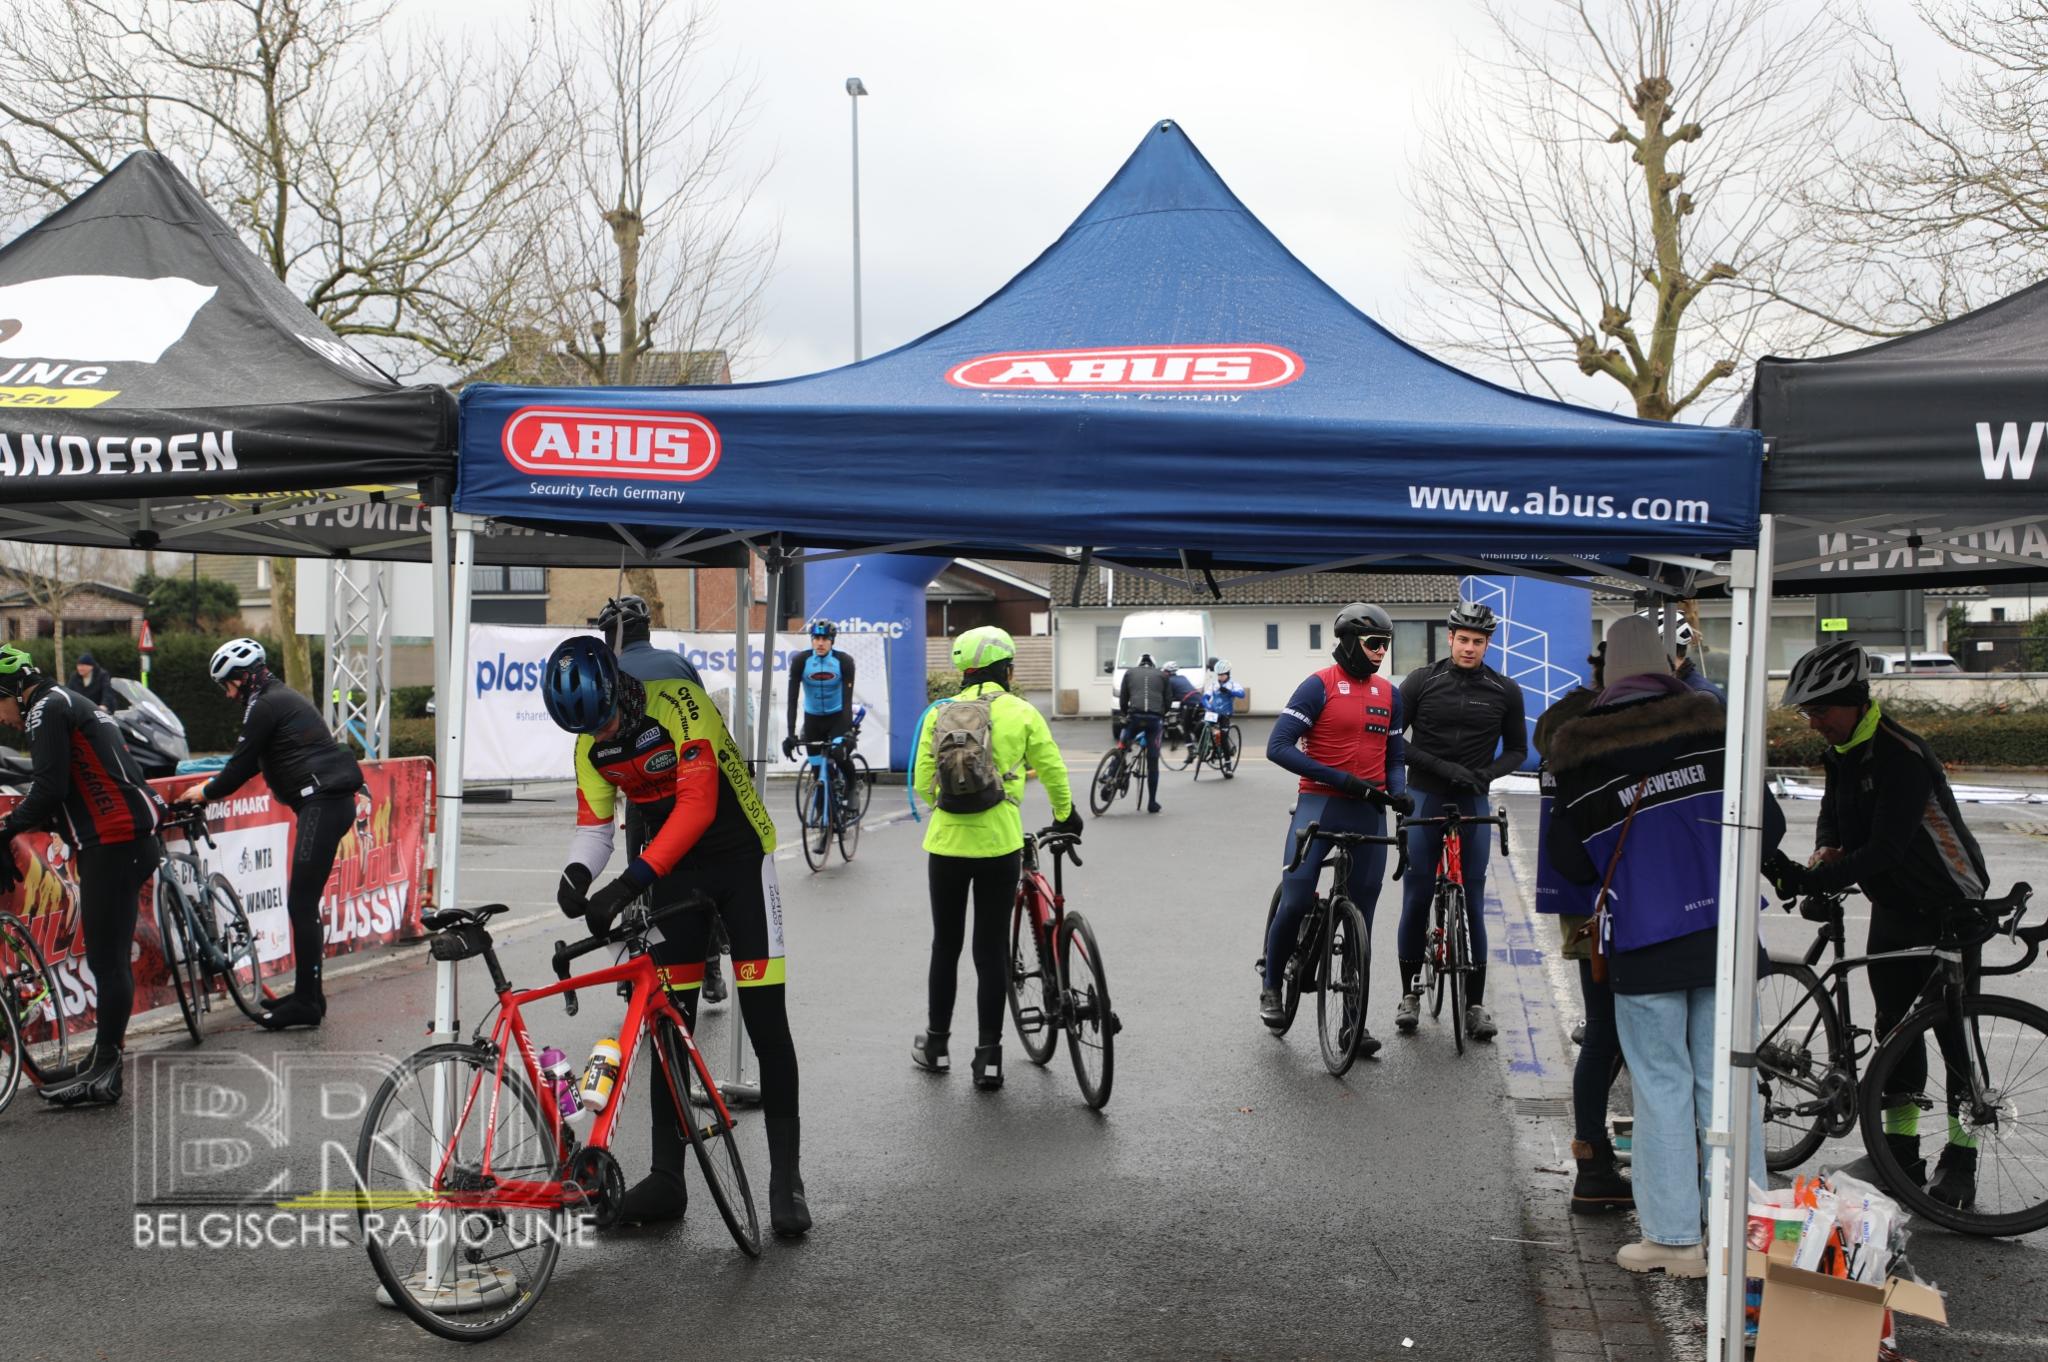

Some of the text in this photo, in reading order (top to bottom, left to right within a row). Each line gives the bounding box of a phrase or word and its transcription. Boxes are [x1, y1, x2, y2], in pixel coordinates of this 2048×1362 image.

[988, 356, 1252, 384] ABUS
[530, 422, 690, 464] ABUS
[529, 482, 686, 503] Security Tech Germany
[1408, 485, 1709, 524] www.abus.com
[232, 796, 271, 818] MAART
[727, 762, 771, 837] 060/21.50.26
[255, 848, 272, 872] MTB
[245, 886, 283, 915] WANDEL
